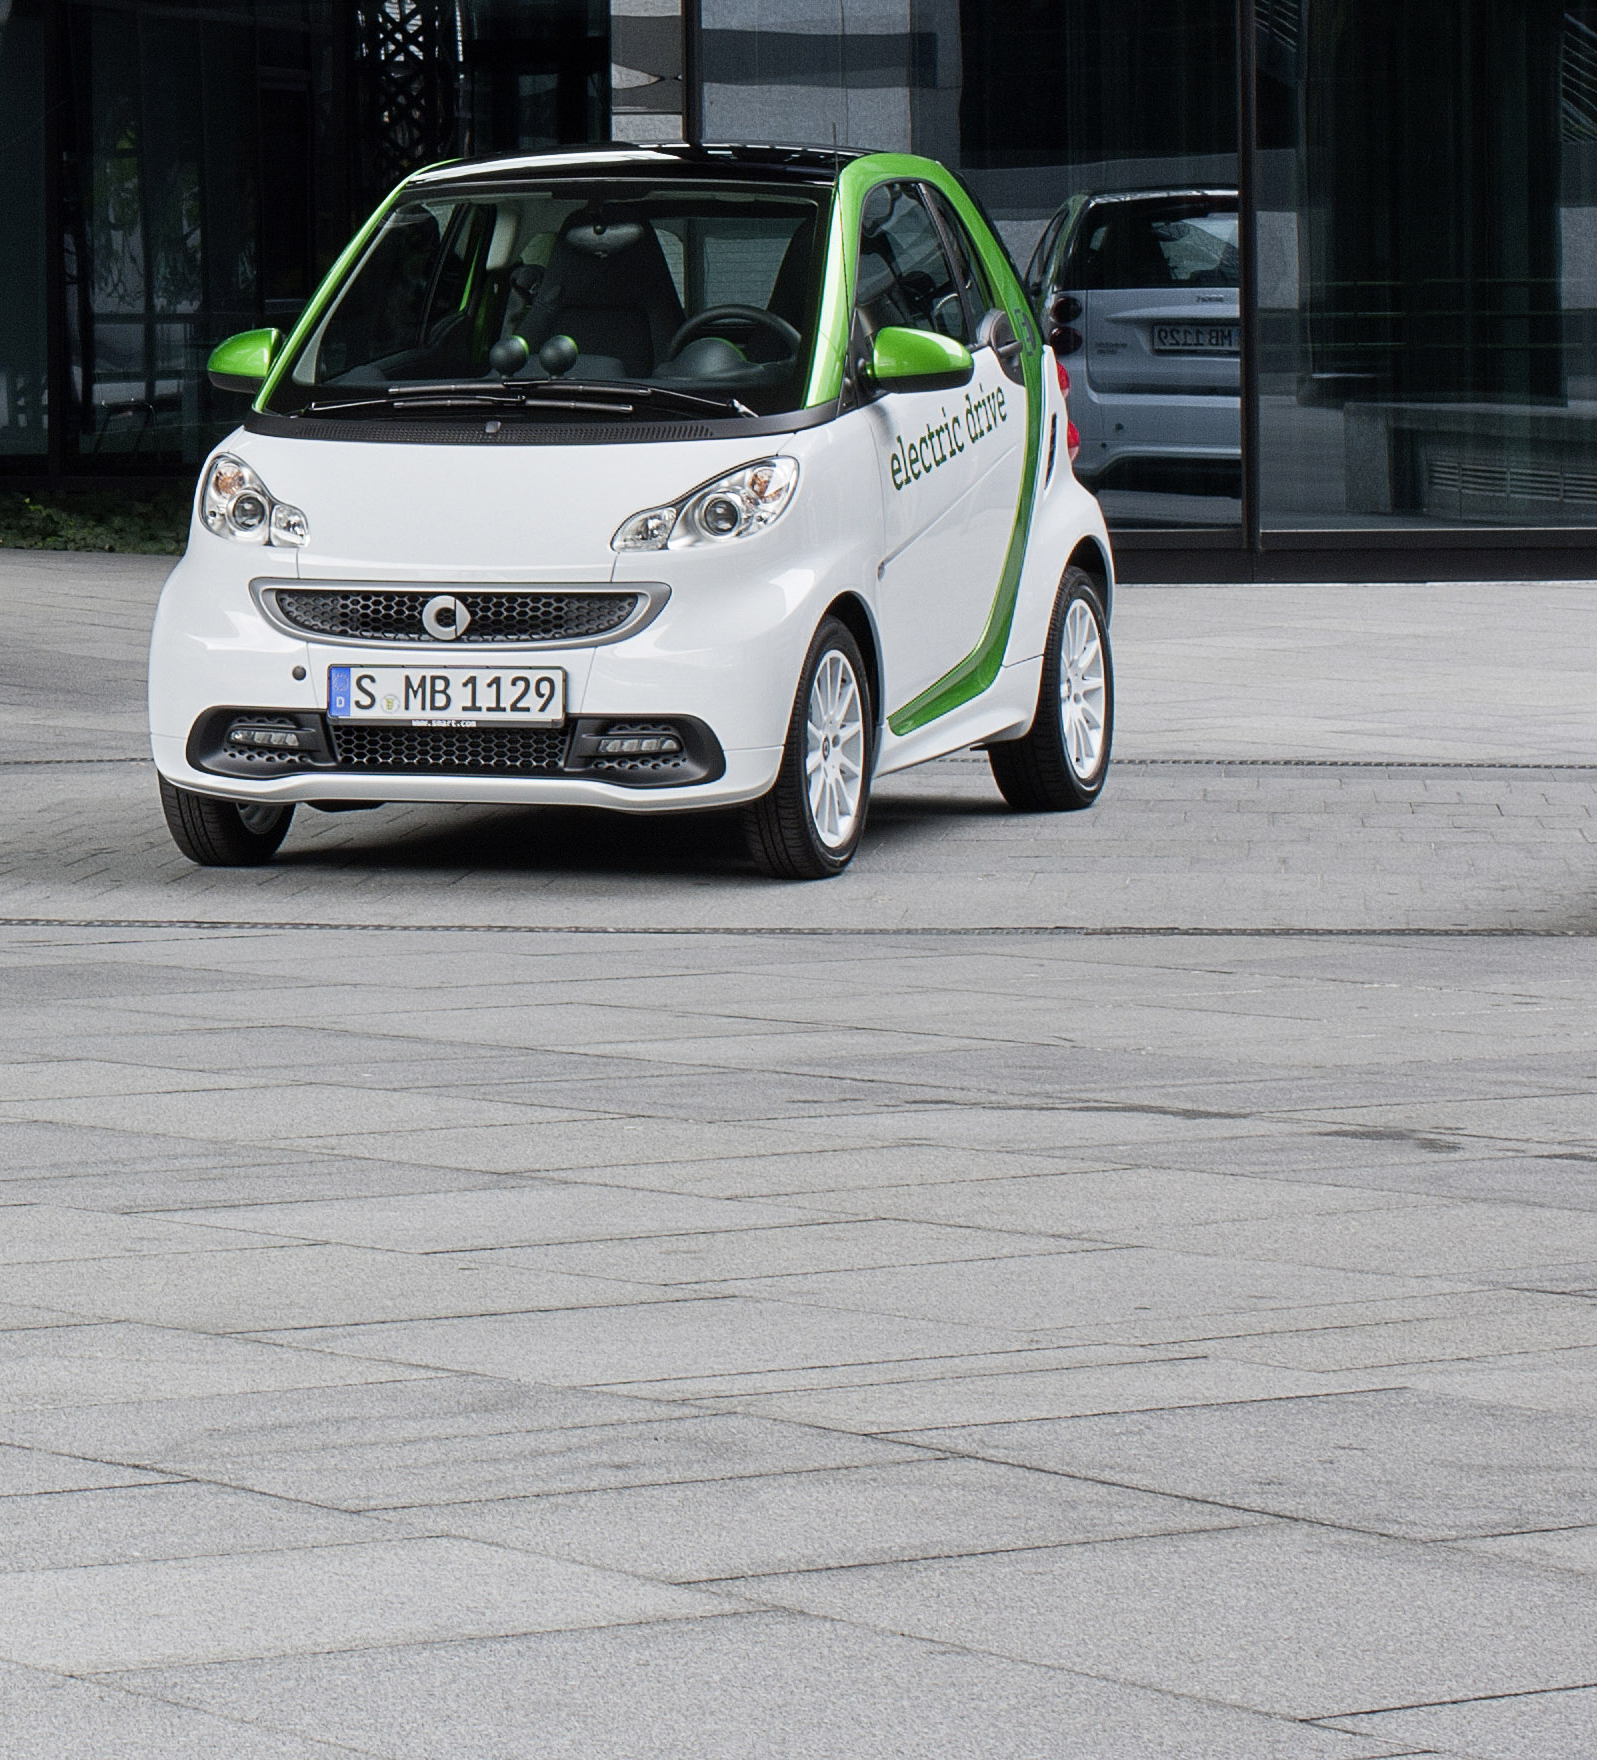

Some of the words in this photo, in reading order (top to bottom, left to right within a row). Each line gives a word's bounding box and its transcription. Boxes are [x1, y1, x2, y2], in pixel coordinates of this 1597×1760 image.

[890, 406, 965, 491] electric
[965, 382, 1008, 444] drive
[336, 696, 345, 708] D
[354, 673, 376, 711] S
[404, 674, 452, 712] MB
[461, 675, 556, 713] 1129
[411, 719, 477, 728] www.smart.com
